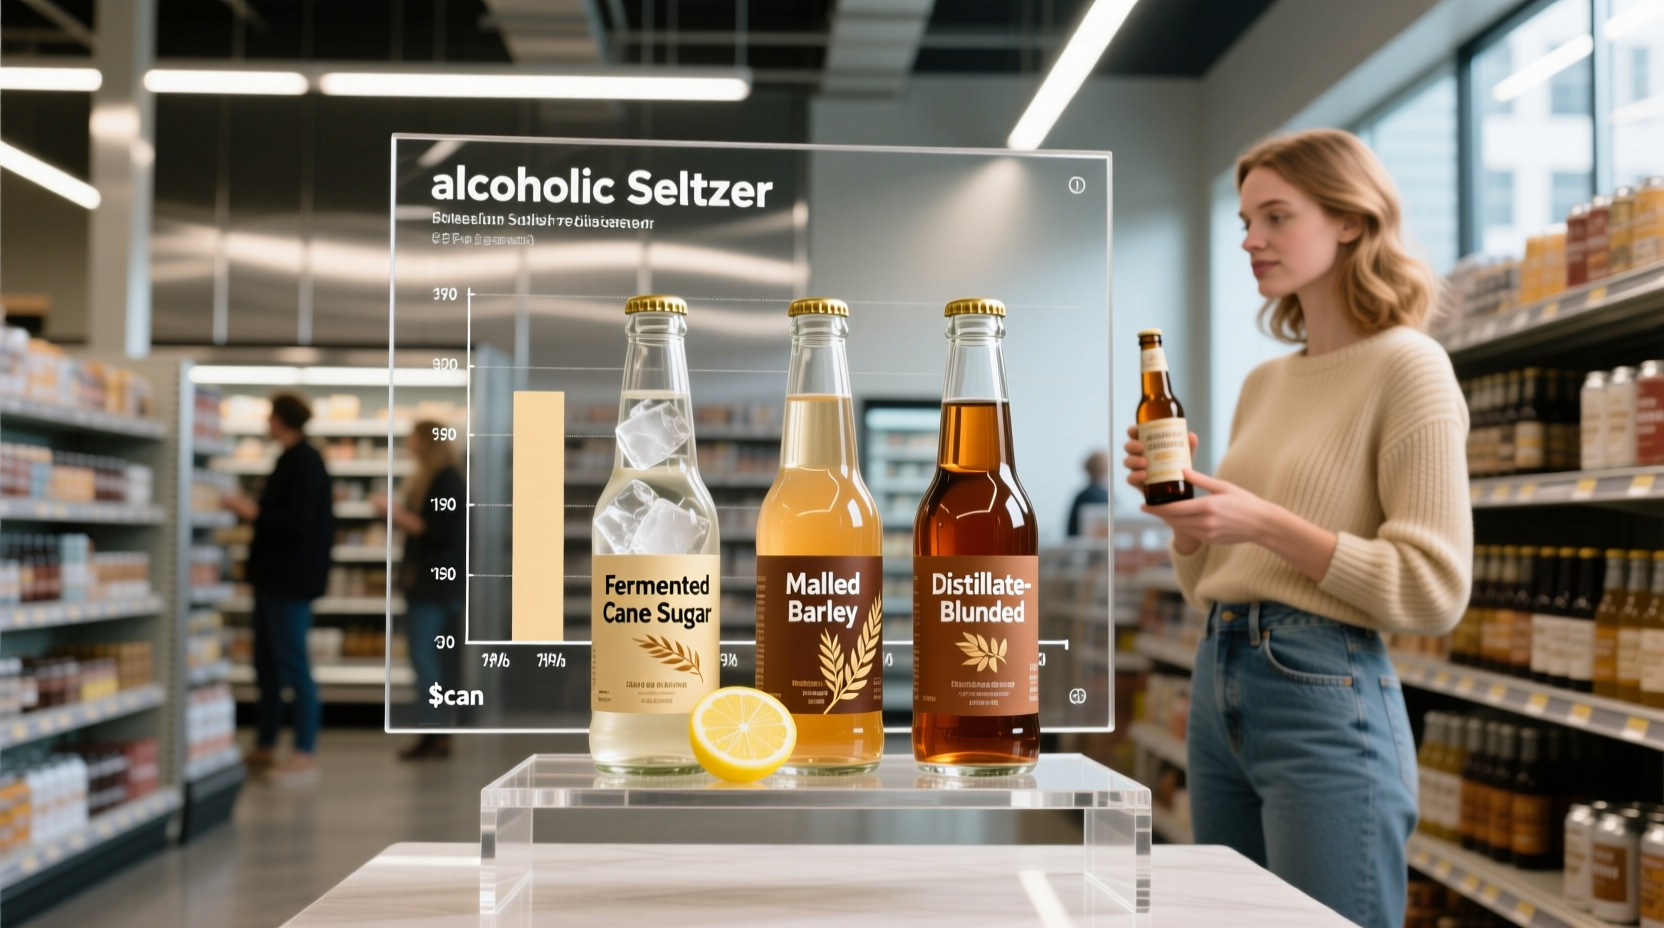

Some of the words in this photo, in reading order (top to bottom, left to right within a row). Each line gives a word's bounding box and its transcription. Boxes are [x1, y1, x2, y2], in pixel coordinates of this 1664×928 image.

[431, 164, 615, 205] alcoholic
[626, 168, 774, 208] Seltzer
[605, 574, 710, 595] Fermented
[786, 571, 860, 596] Malled
[932, 572, 1033, 596] Distillate-
[603, 601, 652, 624] Cane
[656, 601, 712, 630] Sugar
[788, 600, 859, 629] Barley
[940, 600, 1025, 623] Blunded
[428, 681, 484, 709] $can
